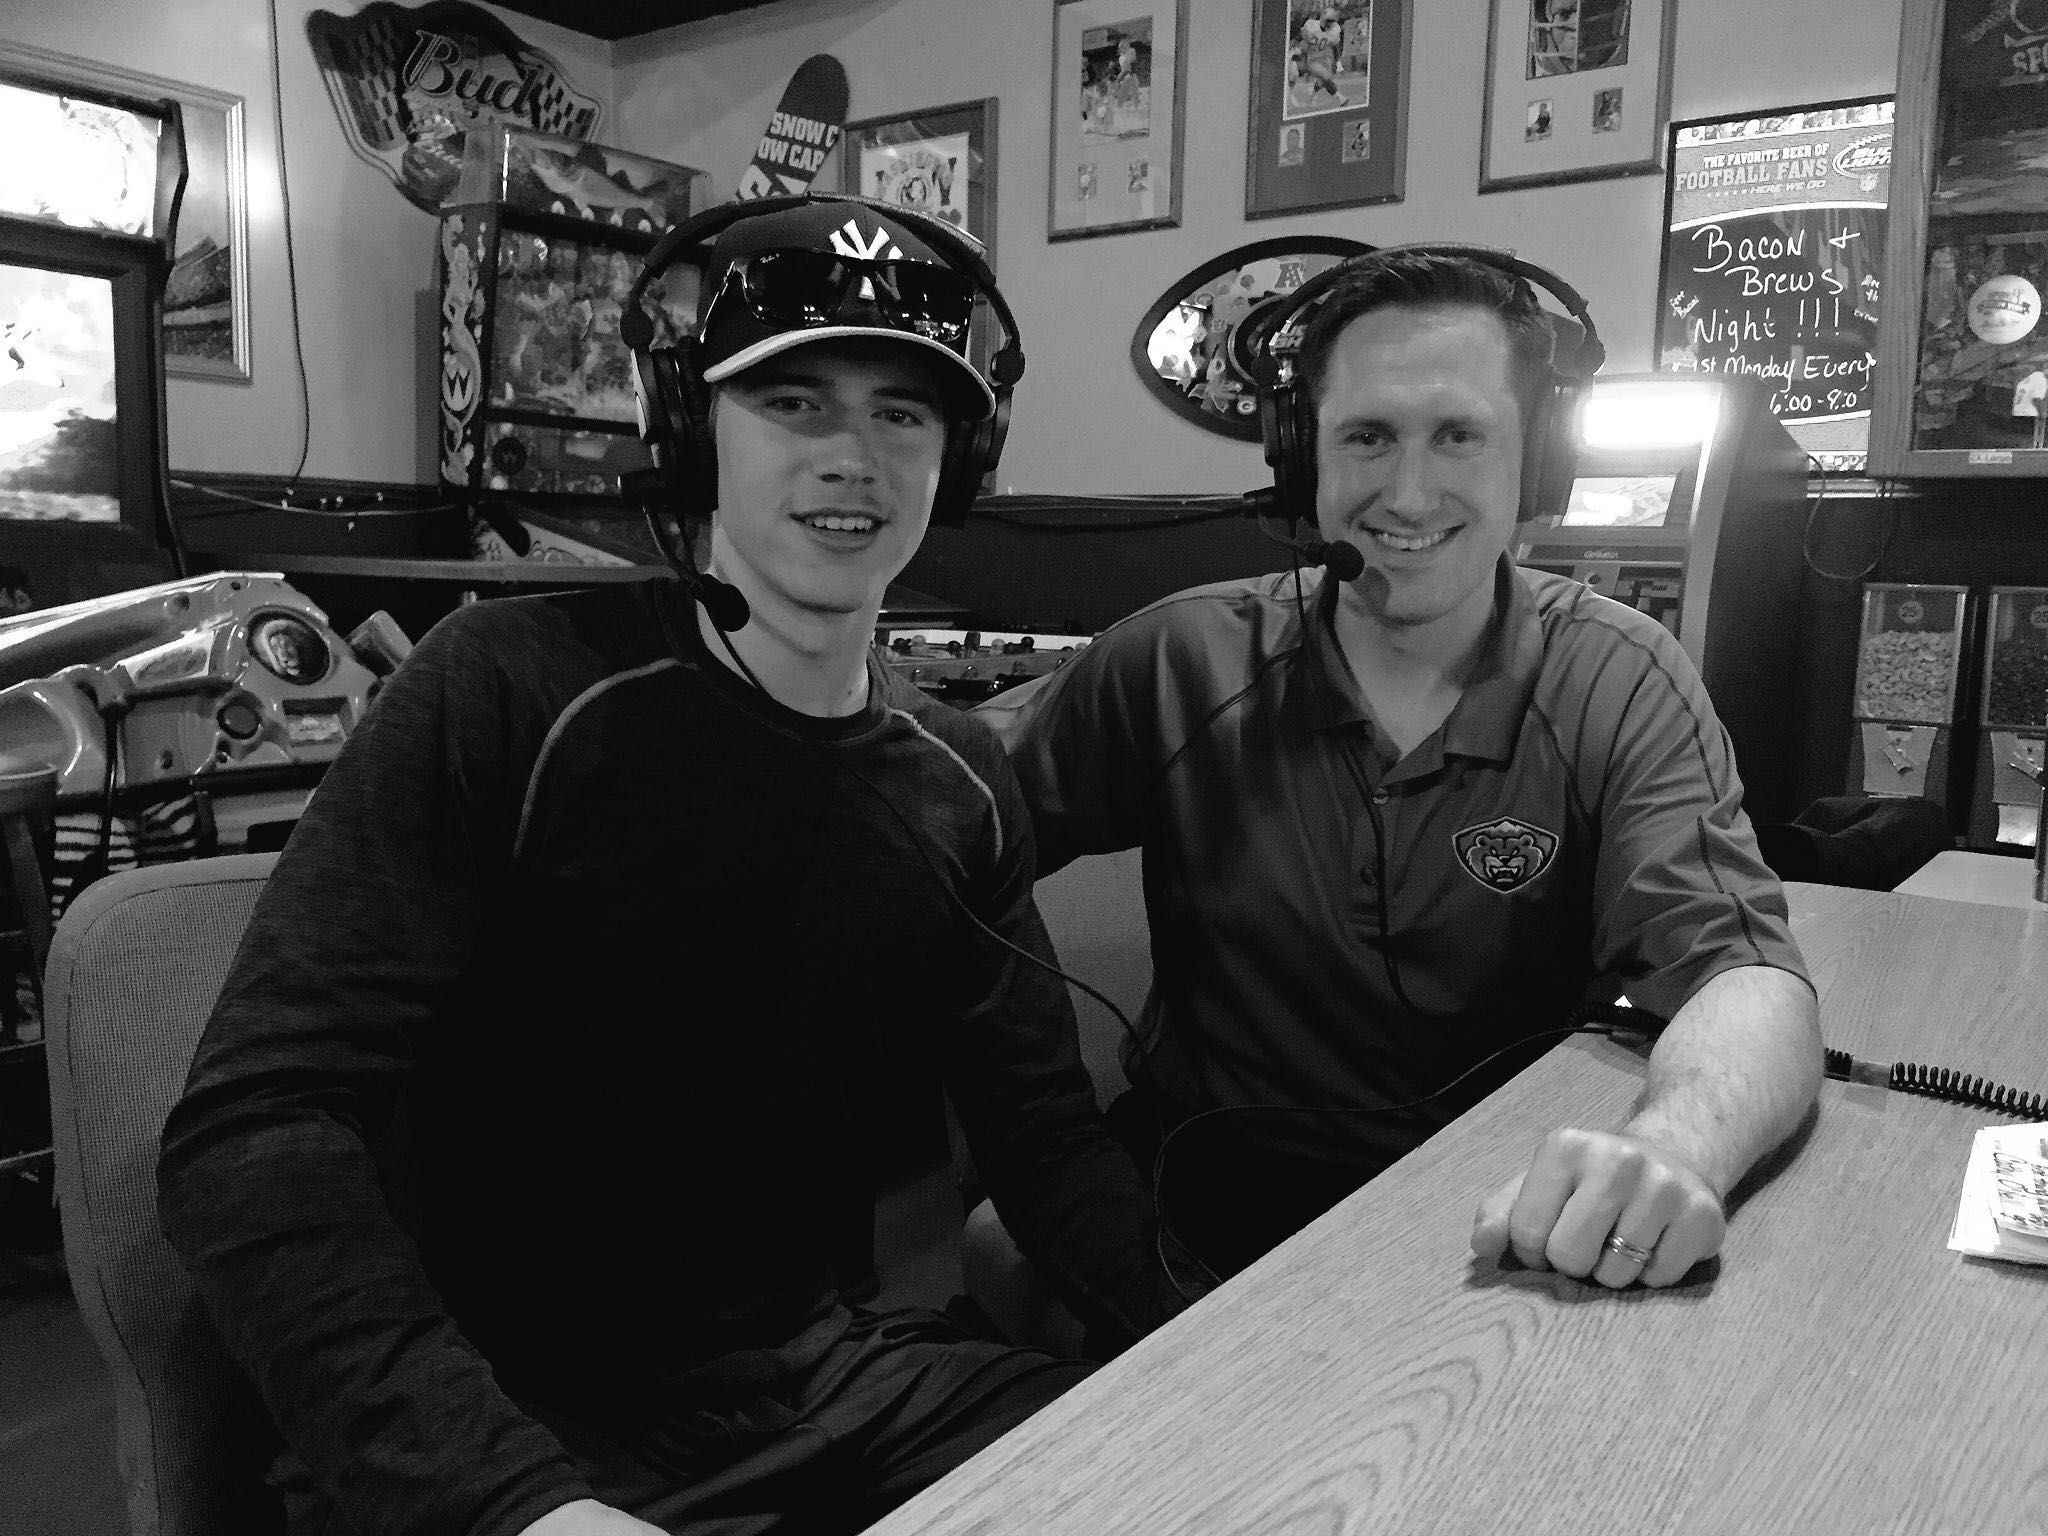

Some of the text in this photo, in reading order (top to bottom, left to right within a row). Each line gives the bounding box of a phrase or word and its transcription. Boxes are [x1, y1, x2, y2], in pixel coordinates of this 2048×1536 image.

[402, 29, 545, 118] Bud
[770, 112, 827, 145] SNOW
[788, 144, 825, 172] CAP
[1704, 143, 1830, 168] THE FAVORITE BEER OF
[1676, 158, 1828, 192] FOOTBALL FANS
[1693, 307, 1776, 353] Night
[1803, 352, 1877, 392] Every
